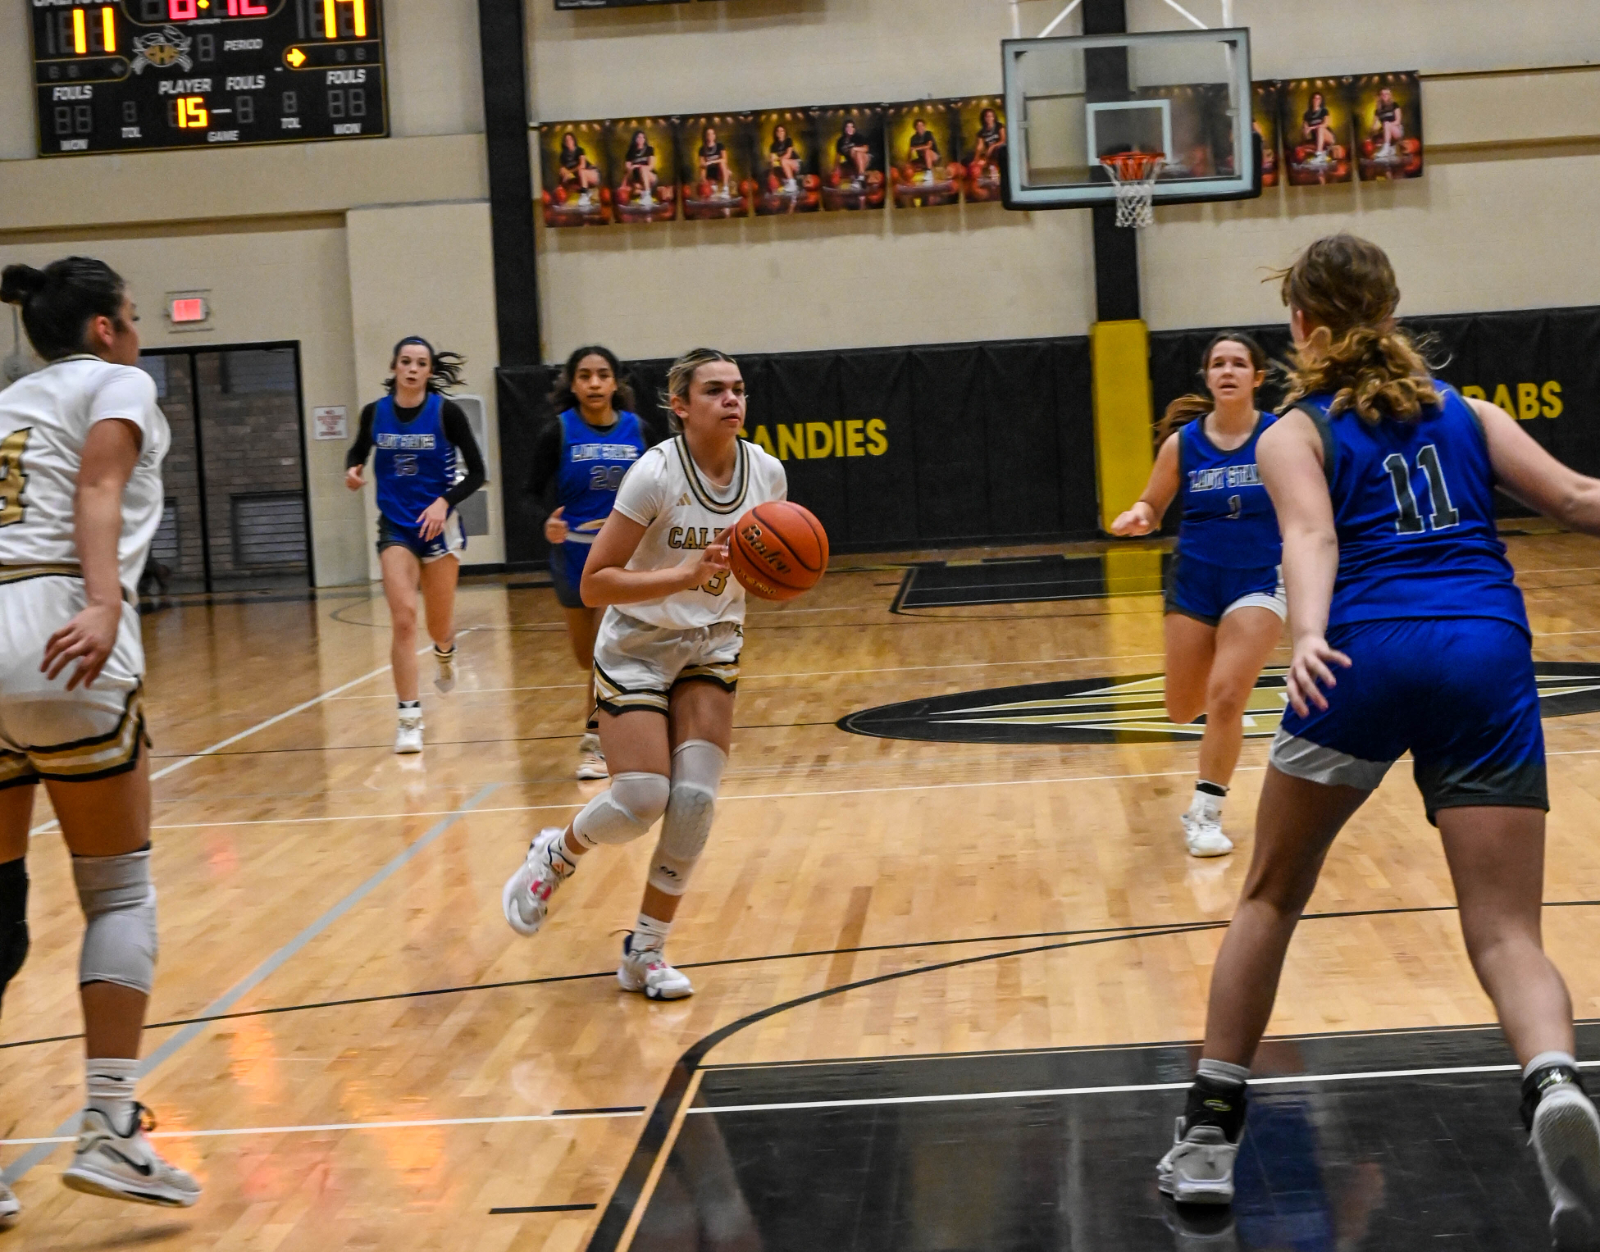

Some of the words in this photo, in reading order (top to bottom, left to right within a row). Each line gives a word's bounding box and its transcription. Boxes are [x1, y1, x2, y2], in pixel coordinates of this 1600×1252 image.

[73, 8, 116, 54] 11
[223, 38, 264, 51] PERIOD
[158, 78, 213, 95] PLAYER
[225, 75, 266, 91] FOULS
[326, 69, 367, 85] FOULS
[52, 85, 93, 101] FOULS
[177, 97, 208, 129] 15
[206, 130, 240, 142] GAME
[333, 123, 362, 135] WON
[739, 418, 889, 461] ANDIES
[1188, 467, 1227, 492] LADY
[1382, 444, 1460, 535] 11
[1225, 494, 1242, 519] 1
